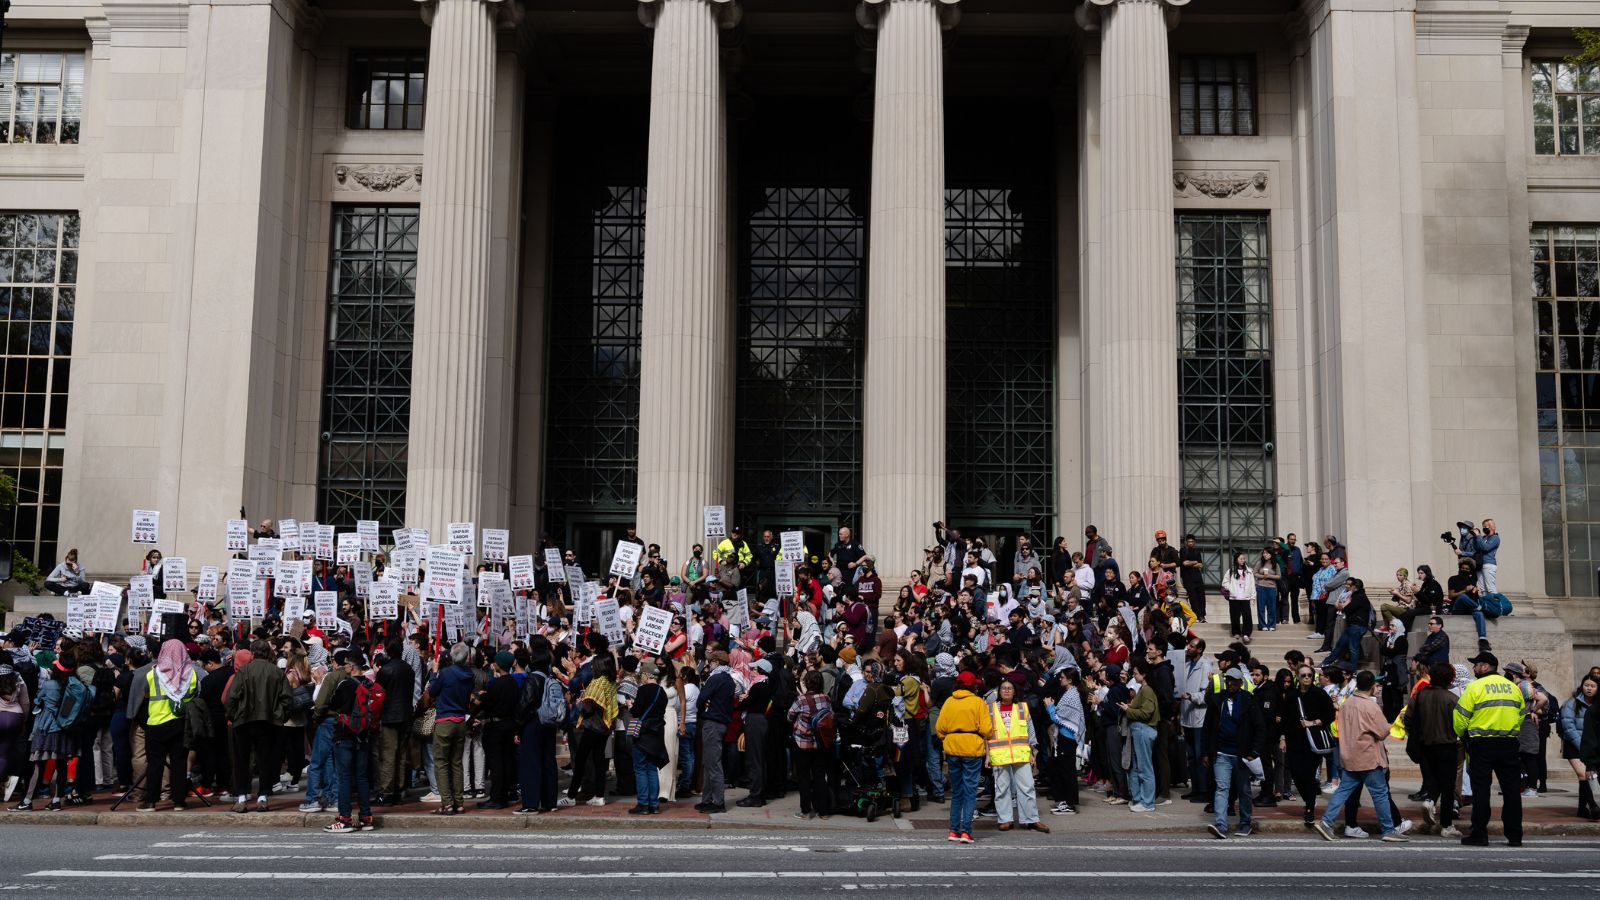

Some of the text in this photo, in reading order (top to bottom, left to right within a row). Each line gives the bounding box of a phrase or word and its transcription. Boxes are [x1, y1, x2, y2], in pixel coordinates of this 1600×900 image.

[647, 615, 665, 624] UNFAIR
[645, 622, 662, 630] LABOR
[639, 628, 663, 639] PRACTICE!
[1485, 683, 1512, 694] POLICE
